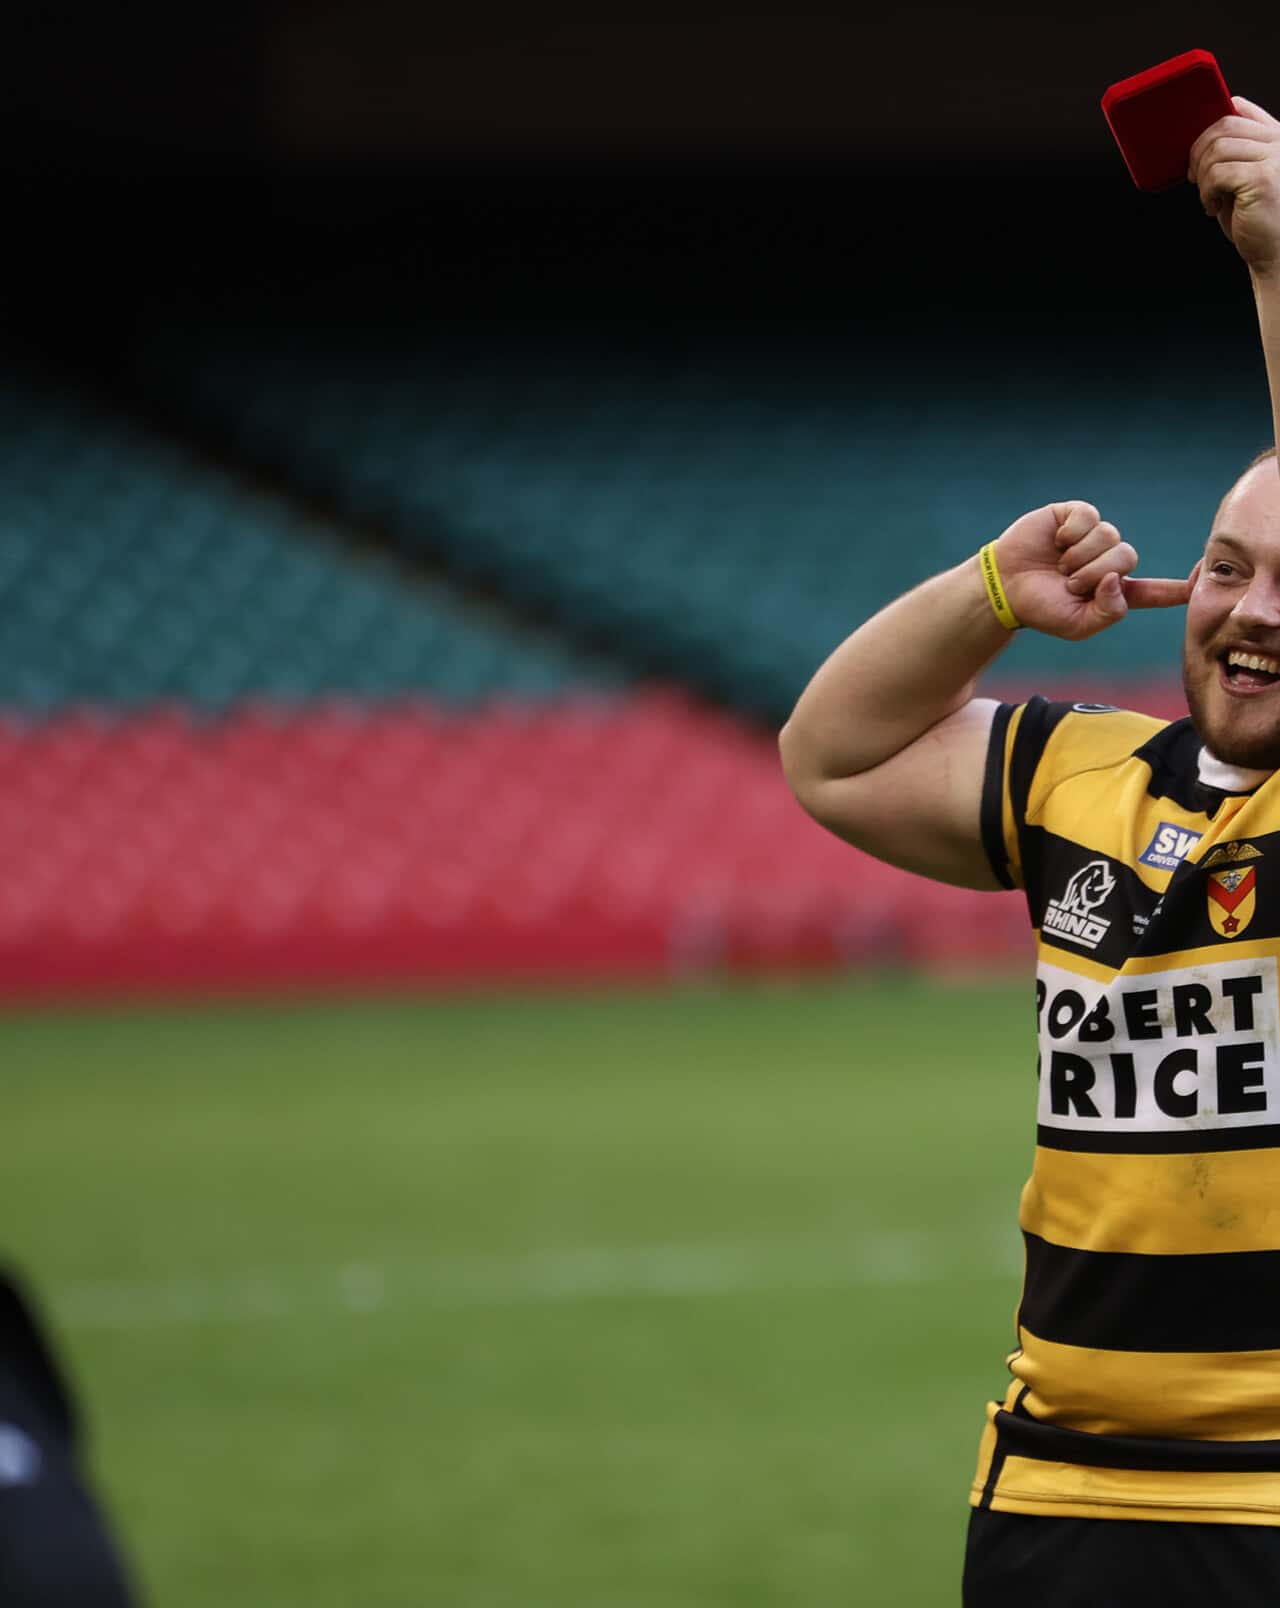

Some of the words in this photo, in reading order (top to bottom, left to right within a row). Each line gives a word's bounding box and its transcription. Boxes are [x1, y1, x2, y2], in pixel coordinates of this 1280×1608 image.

[1154, 827, 1200, 858] SW
[1043, 905, 1109, 943] RHINO
[1037, 1042, 1268, 1119] RICE
